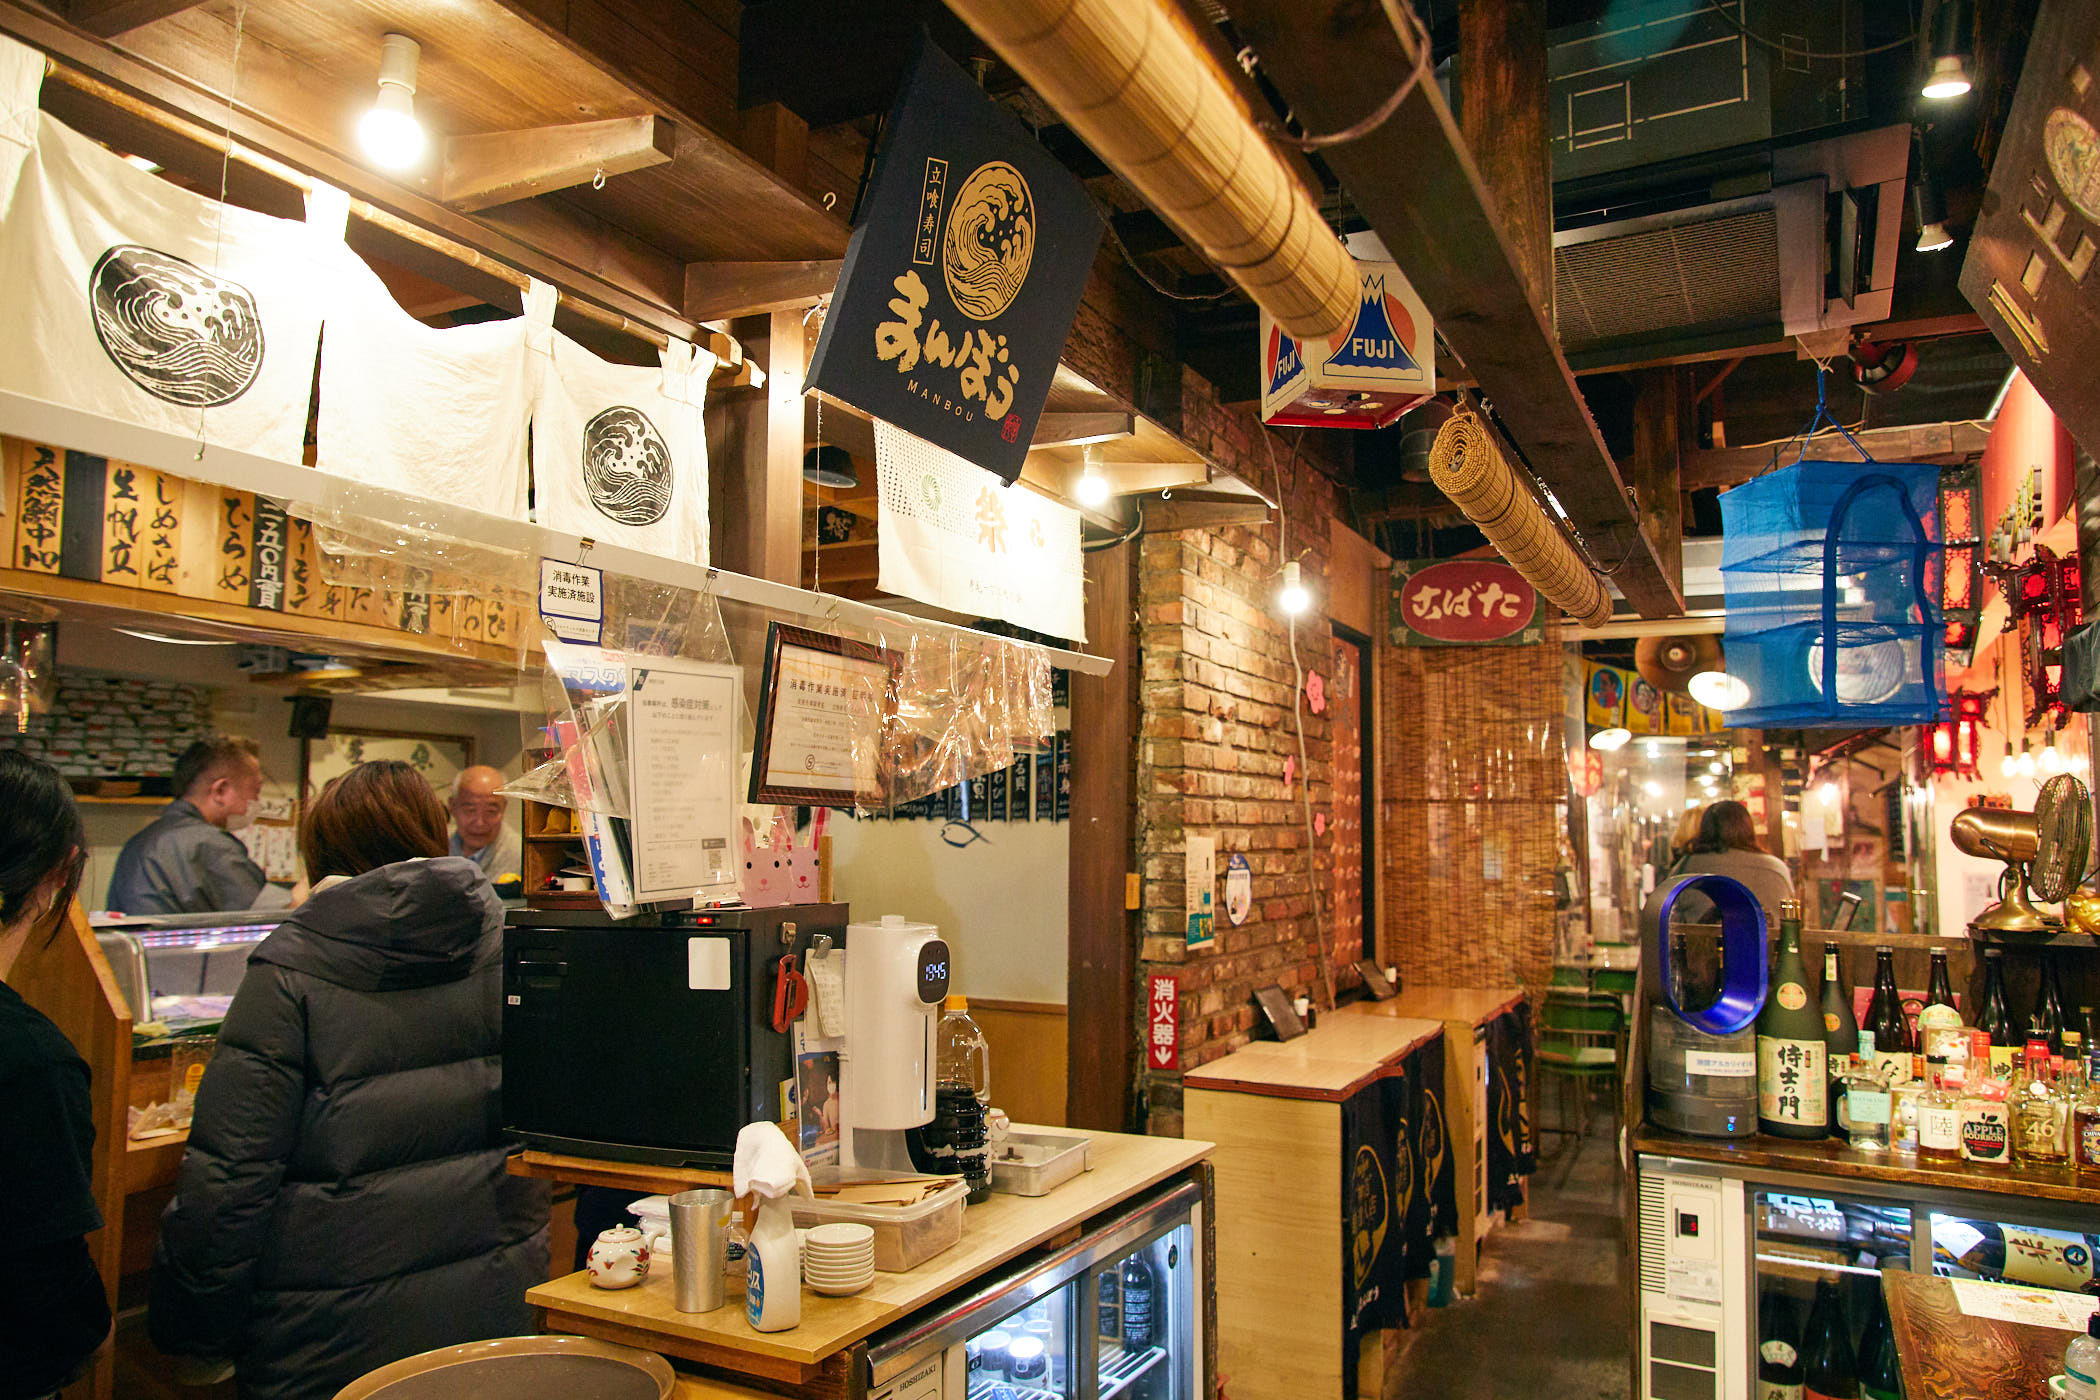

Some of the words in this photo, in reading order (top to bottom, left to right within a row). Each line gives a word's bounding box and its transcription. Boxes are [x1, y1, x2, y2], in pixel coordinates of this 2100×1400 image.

[919, 166, 942, 258] 立喰寿司
[875, 269, 1020, 421] まんぼう
[1352, 338, 1395, 359] FUJI
[1277, 350, 1295, 380] FUJI
[906, 379, 975, 423] MANBOU
[107, 468, 139, 576] 生帆立
[148, 474, 178, 585] しめさば
[217, 498, 250, 591] ひらめ
[547, 585, 595, 604] 実施済施設
[552, 569, 590, 588] 消毒作業
[1152, 978, 1175, 1046] 消火器
[1777, 1043, 1803, 1120] 侍士の門
[1963, 1122, 2004, 1136] APPLE
[1963, 1132, 2005, 1143] BOURBON
[2025, 1118, 2056, 1142] 46
[899, 1364, 937, 1392] HOSHIZAKI
